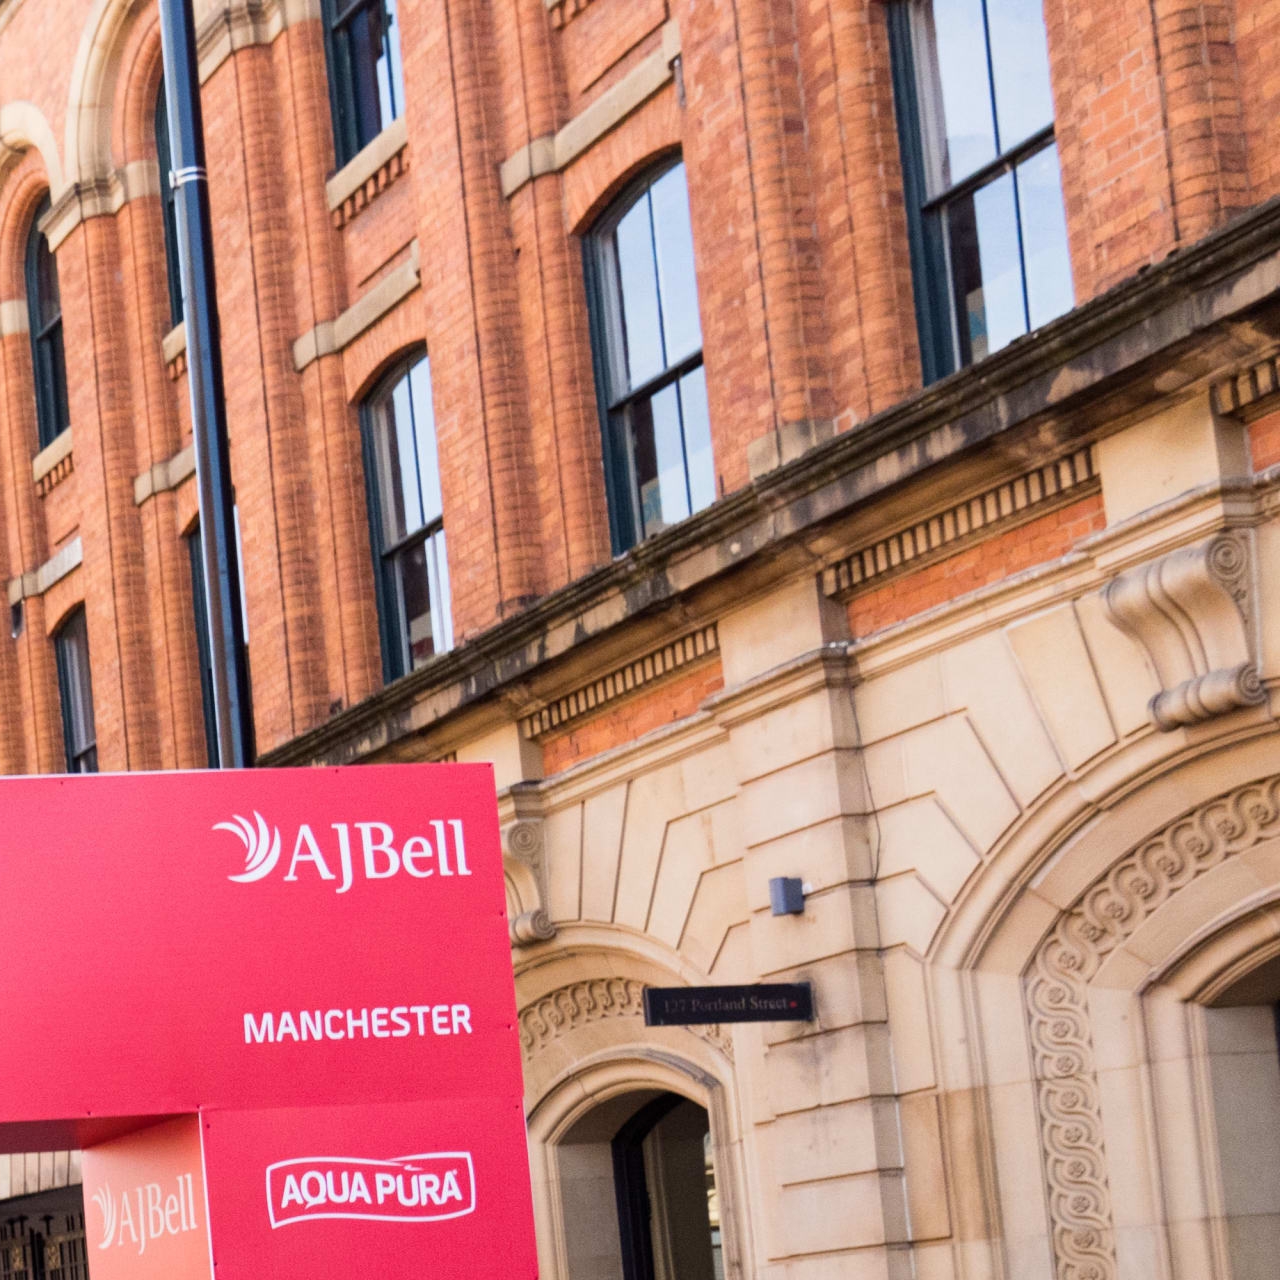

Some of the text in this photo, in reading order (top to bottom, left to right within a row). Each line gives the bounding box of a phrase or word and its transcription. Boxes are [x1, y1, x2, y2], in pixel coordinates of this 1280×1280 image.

[691, 996, 746, 1012] Portland
[749, 994, 788, 1009] Street
[243, 1003, 473, 1045] MANCHESTER
[281, 1170, 373, 1210] AQUA
